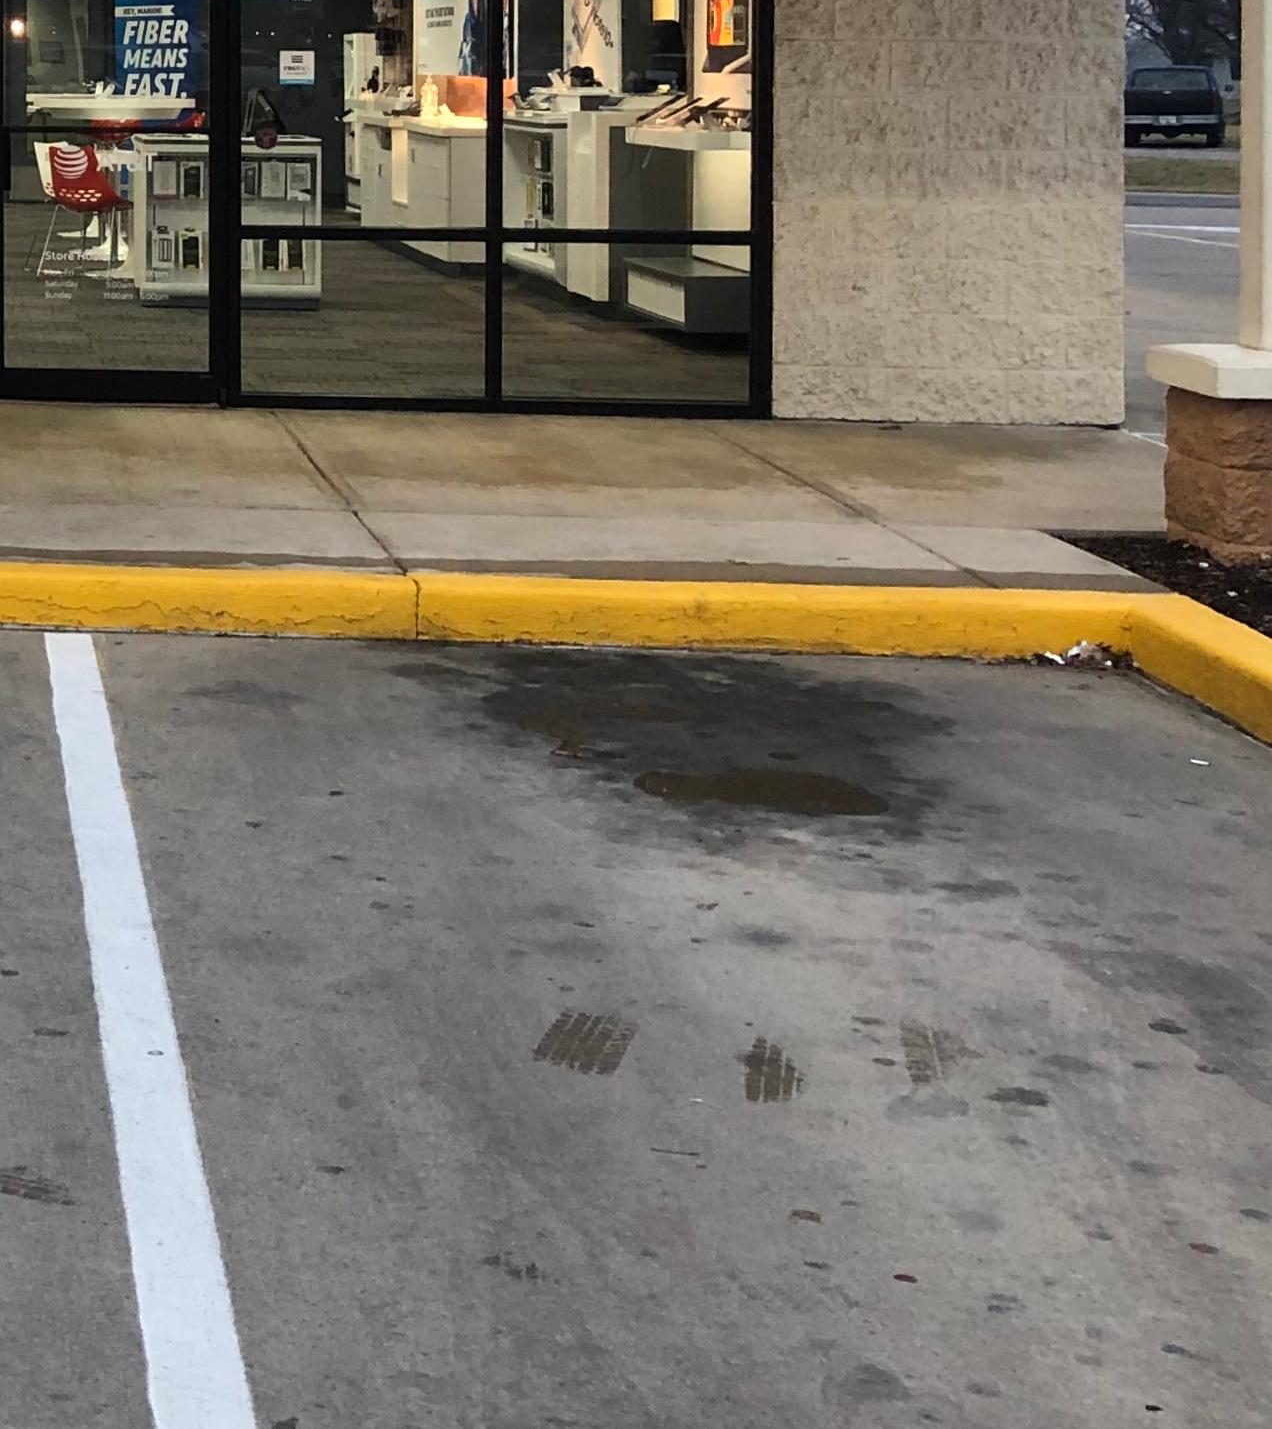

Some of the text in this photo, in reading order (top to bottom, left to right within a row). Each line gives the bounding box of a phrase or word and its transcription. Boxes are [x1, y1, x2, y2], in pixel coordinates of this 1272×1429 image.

[123, 20, 189, 45] FIBER
[123, 48, 189, 68] MEANS
[124, 73, 188, 98] FAST.
[45, 251, 74, 261] Store
[45, 291, 72, 300] Sunday
